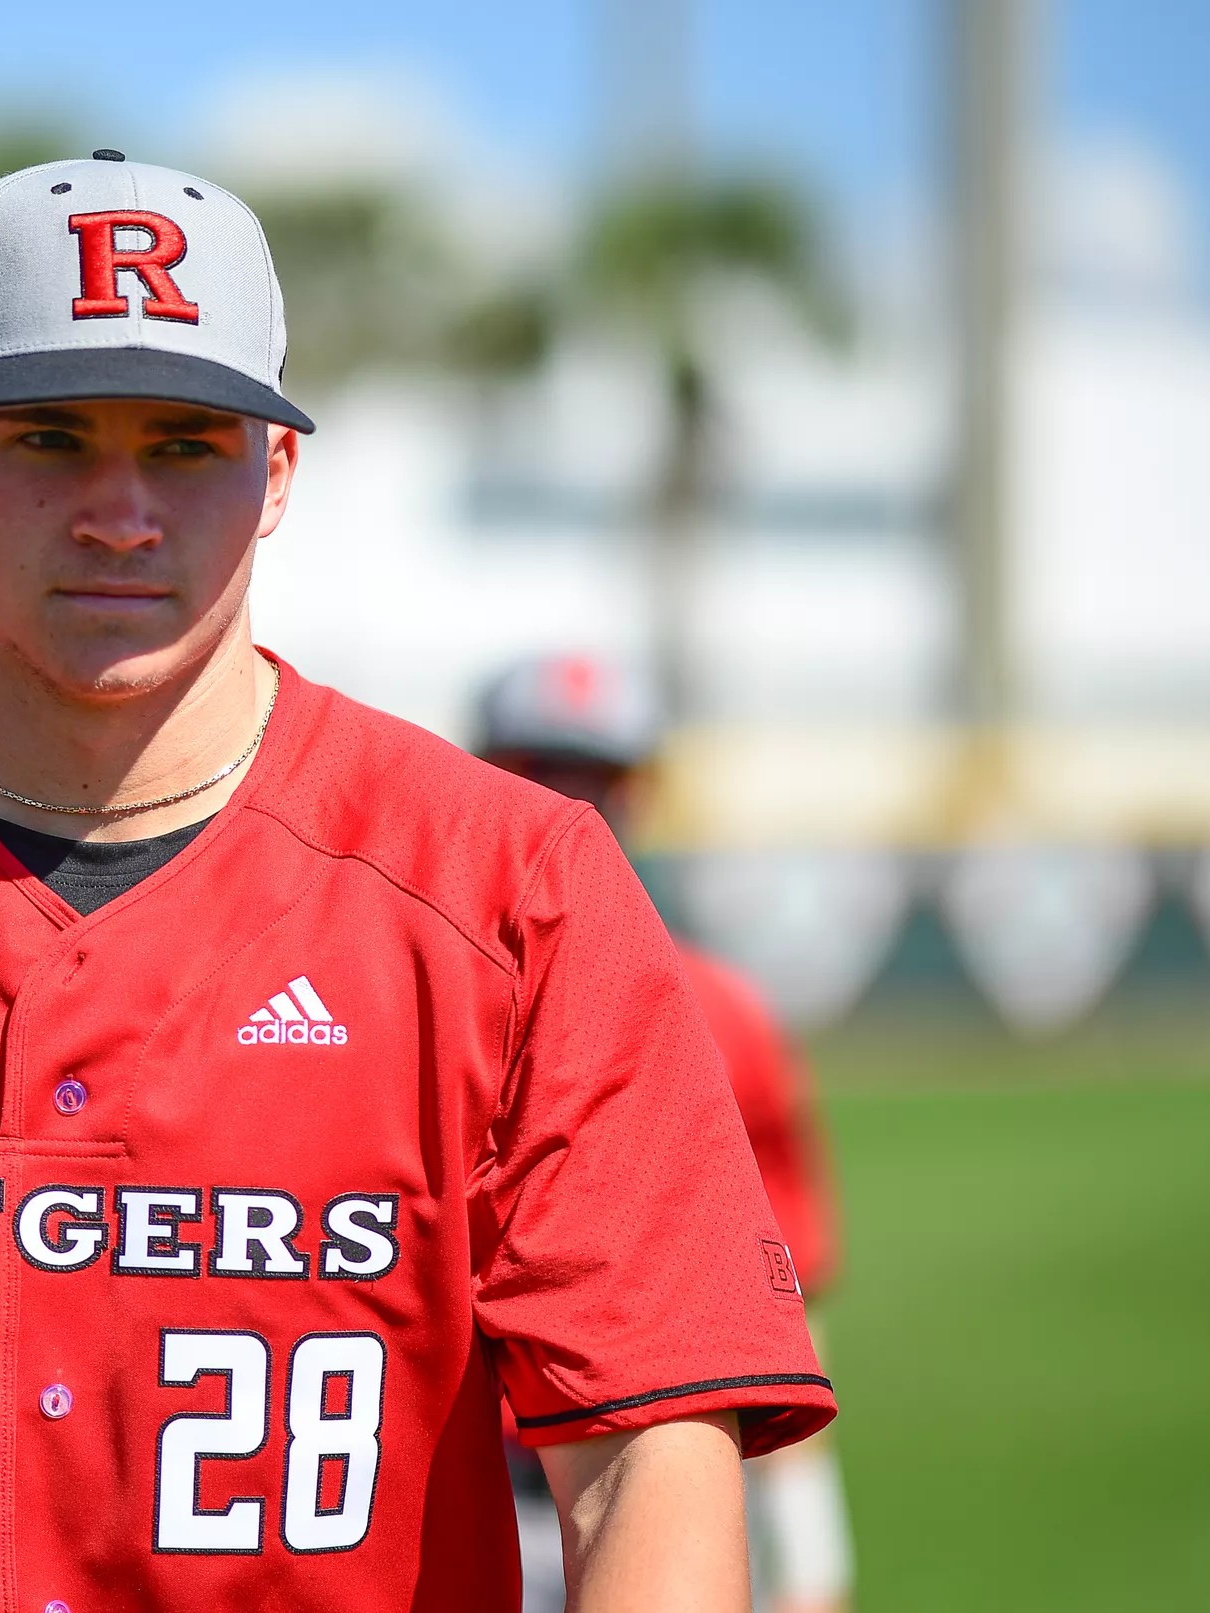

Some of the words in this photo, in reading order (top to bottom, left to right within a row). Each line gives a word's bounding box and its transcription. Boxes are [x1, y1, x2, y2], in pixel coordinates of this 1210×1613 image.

[68, 209, 199, 326] R
[237, 1018, 349, 1046] adidas
[151, 1327, 388, 1556] 28
